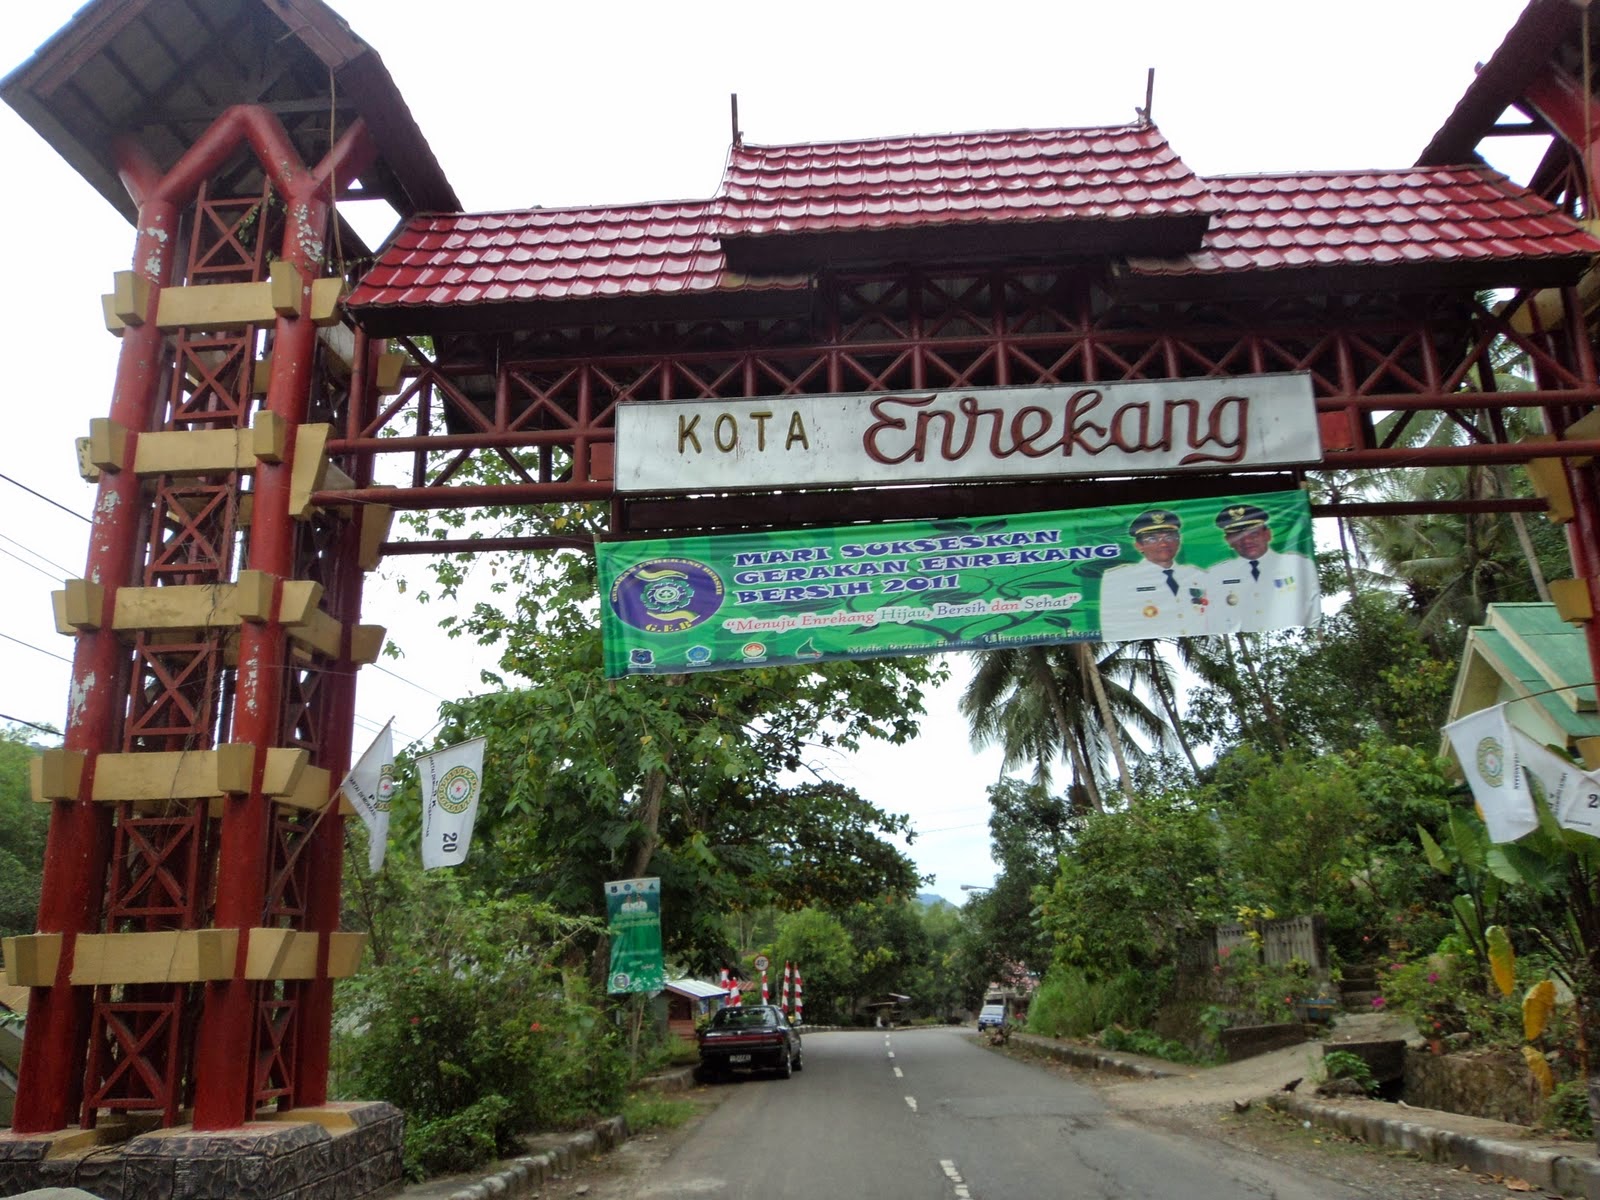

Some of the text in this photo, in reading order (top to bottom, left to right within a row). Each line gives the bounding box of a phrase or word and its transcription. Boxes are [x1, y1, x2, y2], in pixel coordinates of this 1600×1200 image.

[678, 389, 1250, 466] KOTA Enrekang
[733, 530, 1061, 568] MARI SUKSESKAN
[733, 543, 1120, 585] GERAKAN ENREKANG
[733, 574, 960, 605] BERSIH 2011
[801, 609, 875, 624] Enrekang
[936, 602, 986, 616] Bersih
[991, 600, 1019, 612] dan
[441, 832, 458, 853] 20
